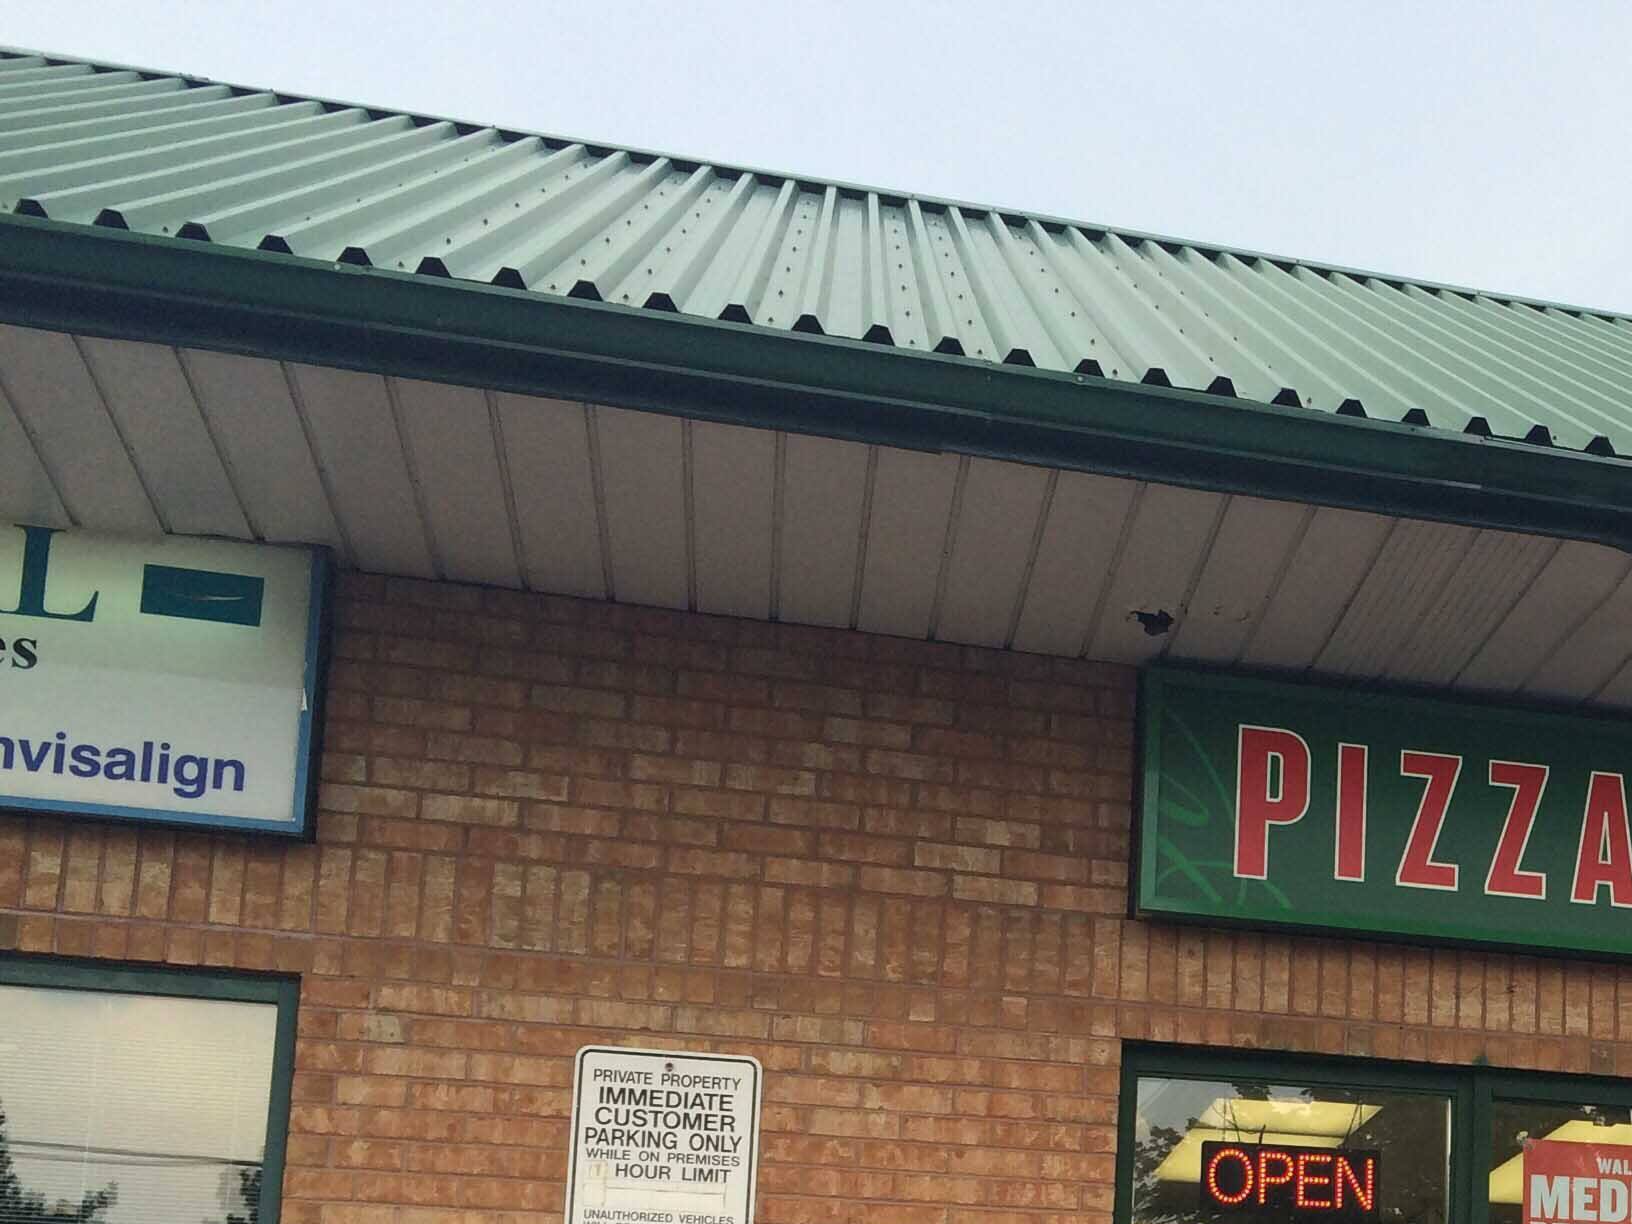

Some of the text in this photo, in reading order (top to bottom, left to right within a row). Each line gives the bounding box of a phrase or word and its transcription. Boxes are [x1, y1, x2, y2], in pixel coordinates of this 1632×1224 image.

[0, 637, 38, 669] s
[593, 1069, 741, 1090] PRIVATE PROPERTY
[599, 1087, 734, 1111] IMMEDIATE
[595, 1107, 735, 1132] CUSTOMER
[584, 1127, 742, 1153] PARKING ONLY
[586, 1149, 740, 1166] WHILE ON PREMISES
[615, 1164, 731, 1183] HOUR LIMIT
[1207, 1147, 1376, 1212] OPEN
[584, 1209, 673, 1223] UNAUTHORIZED
